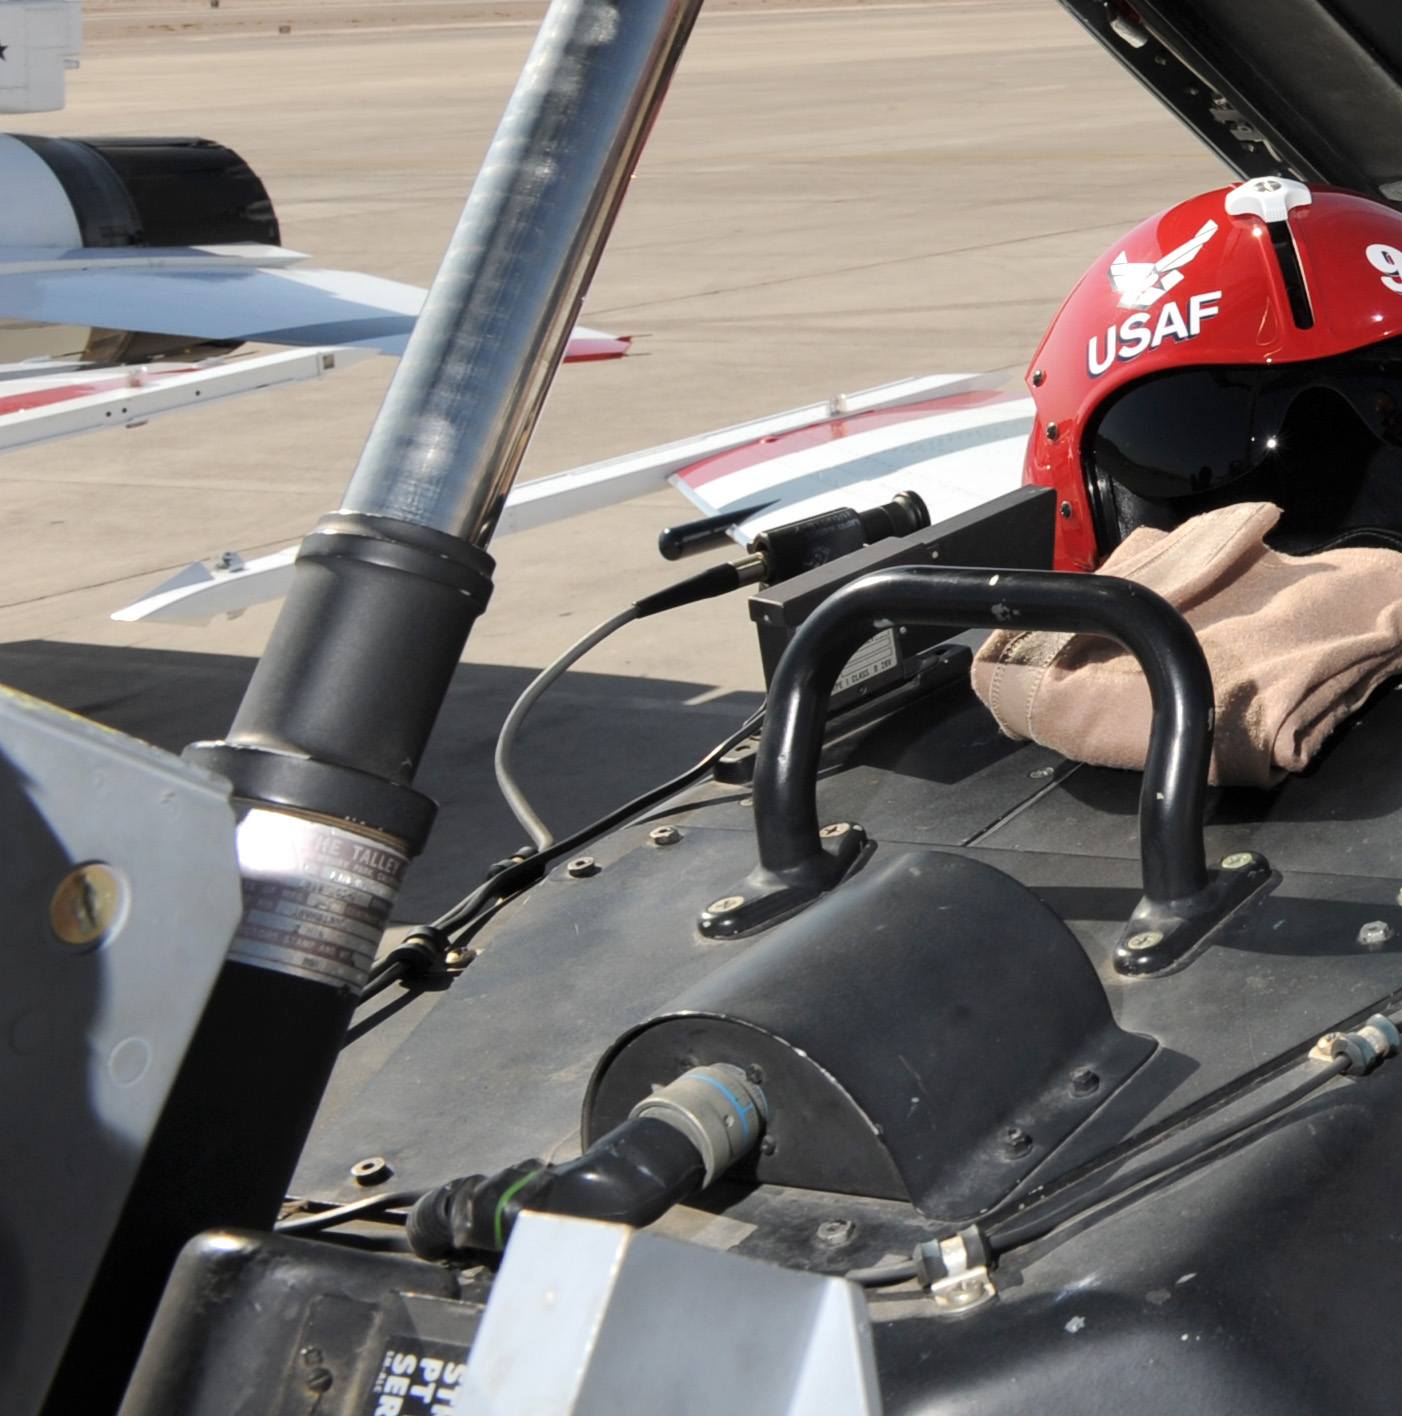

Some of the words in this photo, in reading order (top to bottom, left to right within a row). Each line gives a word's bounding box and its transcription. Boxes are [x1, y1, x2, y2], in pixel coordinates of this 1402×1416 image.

[1087, 290, 1223, 379] USAF
[851, 669, 870, 683] CLASS
[314, 834, 343, 856] HE
[351, 844, 400, 874] TALLEY
[409, 1357, 445, 1404] PT
